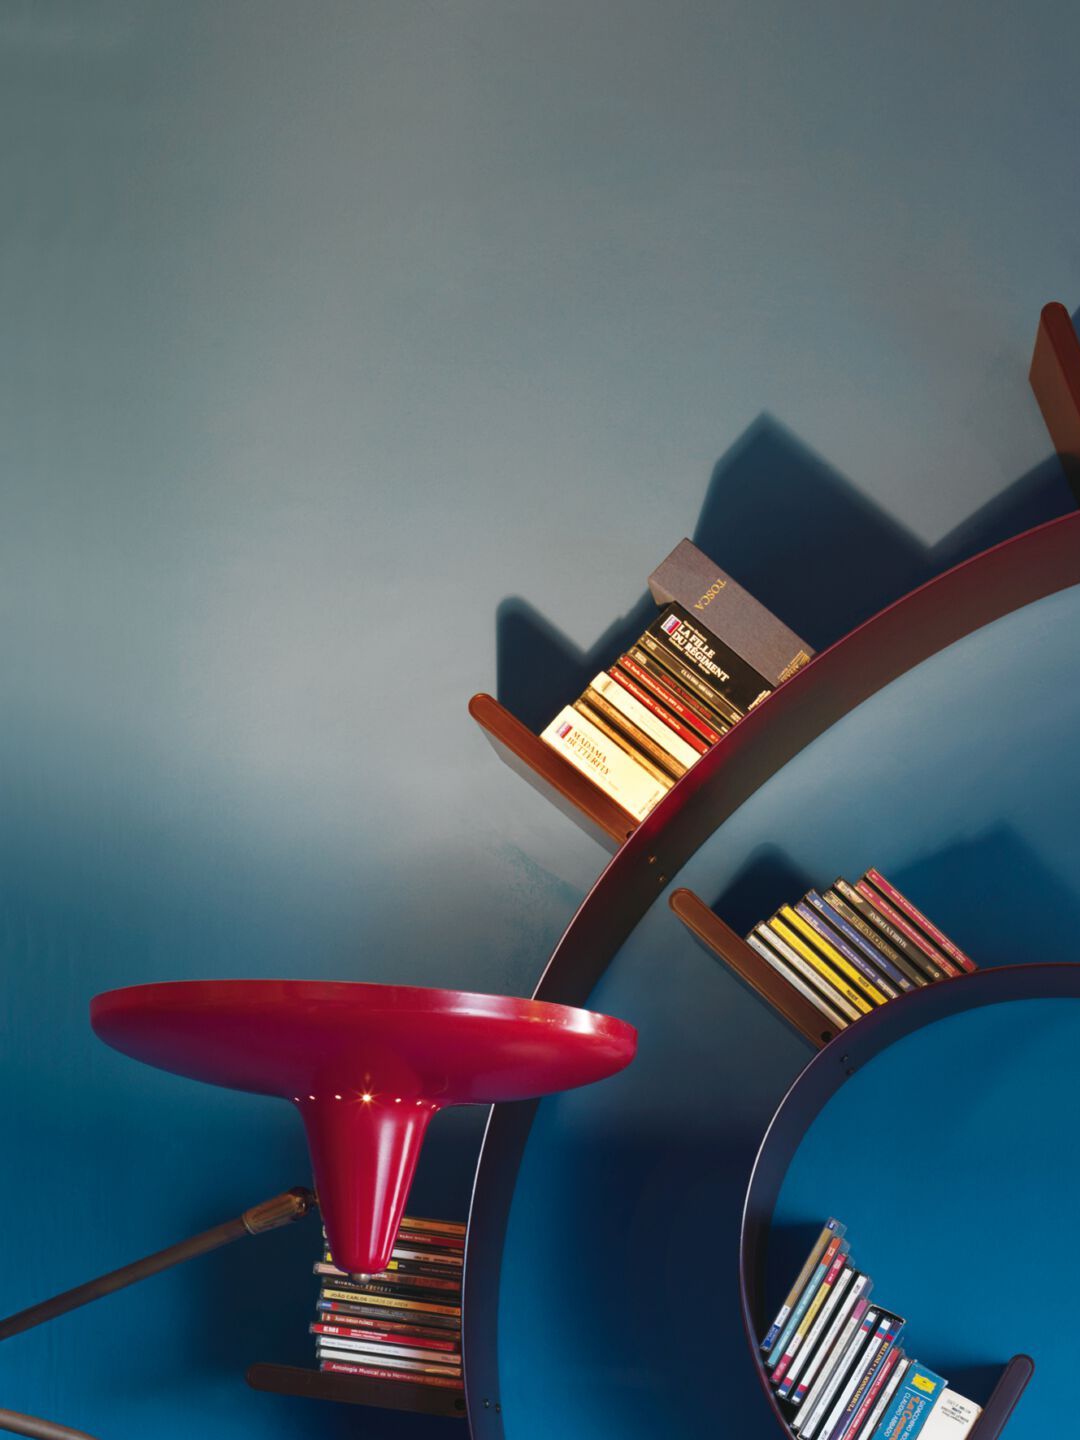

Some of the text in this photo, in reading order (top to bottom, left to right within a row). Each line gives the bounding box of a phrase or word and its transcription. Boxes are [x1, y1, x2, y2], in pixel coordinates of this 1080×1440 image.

[692, 574, 728, 614] TOSCA
[676, 624, 691, 638] LA
[688, 634, 716, 659] FILLE
[670, 631, 730, 683] DU RÉGIMENT
[571, 730, 608, 763] MADAMA
[322, 1325, 339, 1333] EMI
[873, 1340, 889, 1365] BELLINI
[358, 1367, 378, 1375] Musical
[866, 1367, 875, 1376] LA
[883, 1391, 911, 1437] CLAUDIO ABBADO
[906, 1394, 920, 1411] La
